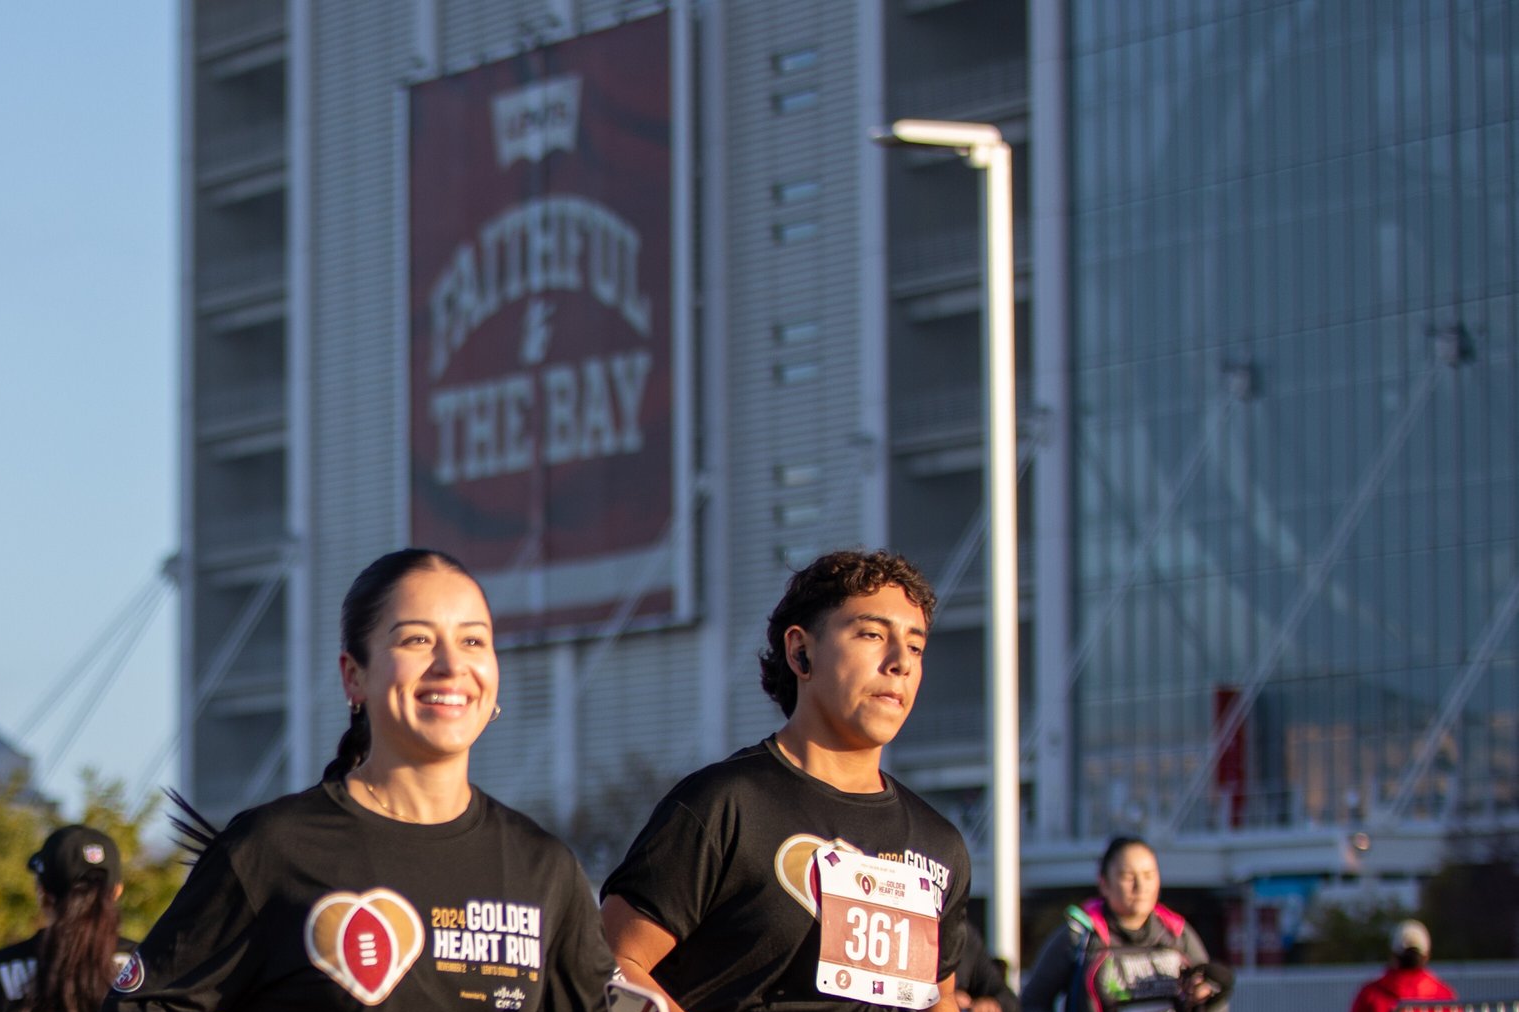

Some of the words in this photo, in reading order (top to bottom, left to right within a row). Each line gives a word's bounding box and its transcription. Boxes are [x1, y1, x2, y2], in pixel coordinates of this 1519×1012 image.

[430, 196, 652, 382] FAITHFUL
[430, 375, 534, 486] THE
[542, 350, 652, 464] BAY
[431, 907, 466, 930] 2024
[466, 900, 541, 938] GOLDEN
[844, 906, 910, 971] 361
[433, 929, 502, 963] HEART
[505, 937, 541, 969] RUN
[839, 973, 847, 987] 2
